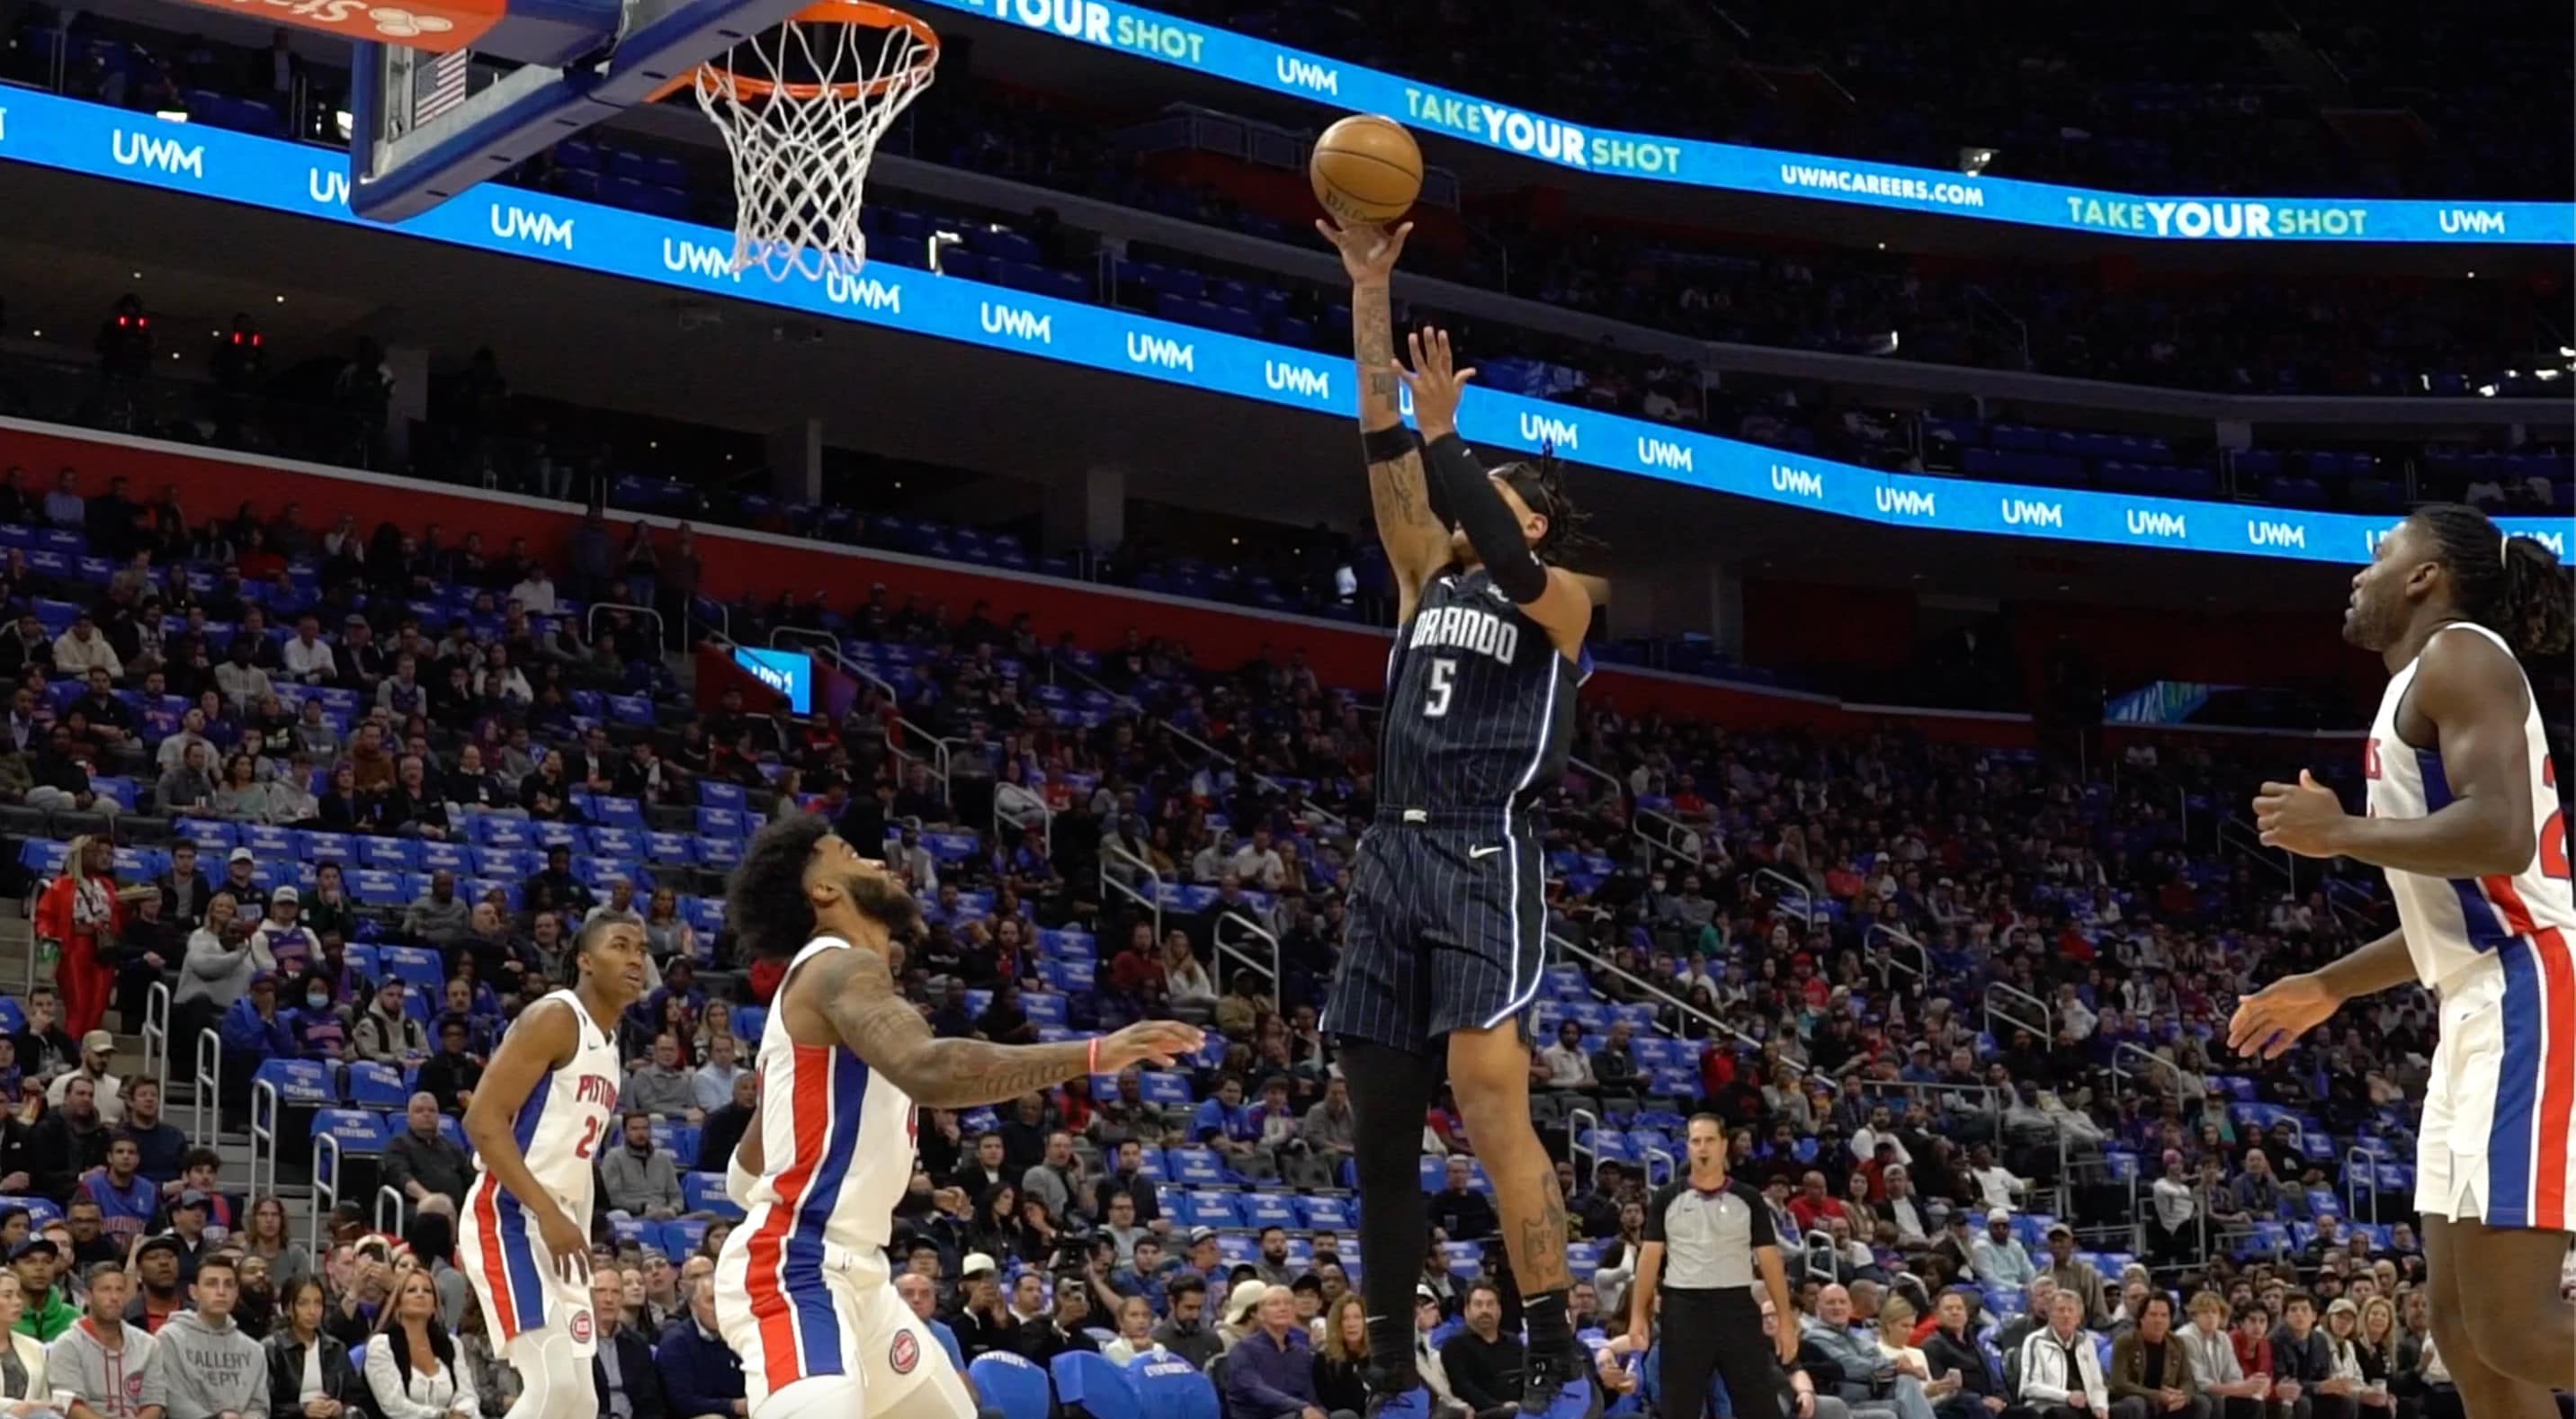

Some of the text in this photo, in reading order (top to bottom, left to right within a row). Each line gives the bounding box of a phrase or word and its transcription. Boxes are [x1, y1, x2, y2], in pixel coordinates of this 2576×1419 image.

[1116, 15, 1203, 63] SHOT
[1277, 55, 1337, 95] UWM
[112, 129, 203, 178] UWM
[1591, 138, 1680, 173] SHOT
[1781, 164, 1984, 208] UWMCAREERS.COM
[491, 204, 574, 250] UWM
[2276, 209, 2367, 236] SHOT
[2438, 210, 2505, 234] UWM
[663, 236, 741, 283] UWM
[826, 270, 901, 314] UWM
[981, 302, 1051, 344] UWM
[1127, 332, 1194, 371] UWM
[1266, 361, 1328, 398] UWM
[1520, 411, 1578, 450] UWM
[1638, 437, 1693, 471] UWM
[1771, 465, 1822, 499] UWM
[1875, 486, 1935, 516] UWM
[2002, 499, 2062, 528] UWM
[2127, 509, 2186, 539] UWM
[2248, 521, 2305, 548] UWM
[1409, 606, 1519, 666] ORANDO
[1424, 658, 1457, 718] 5
